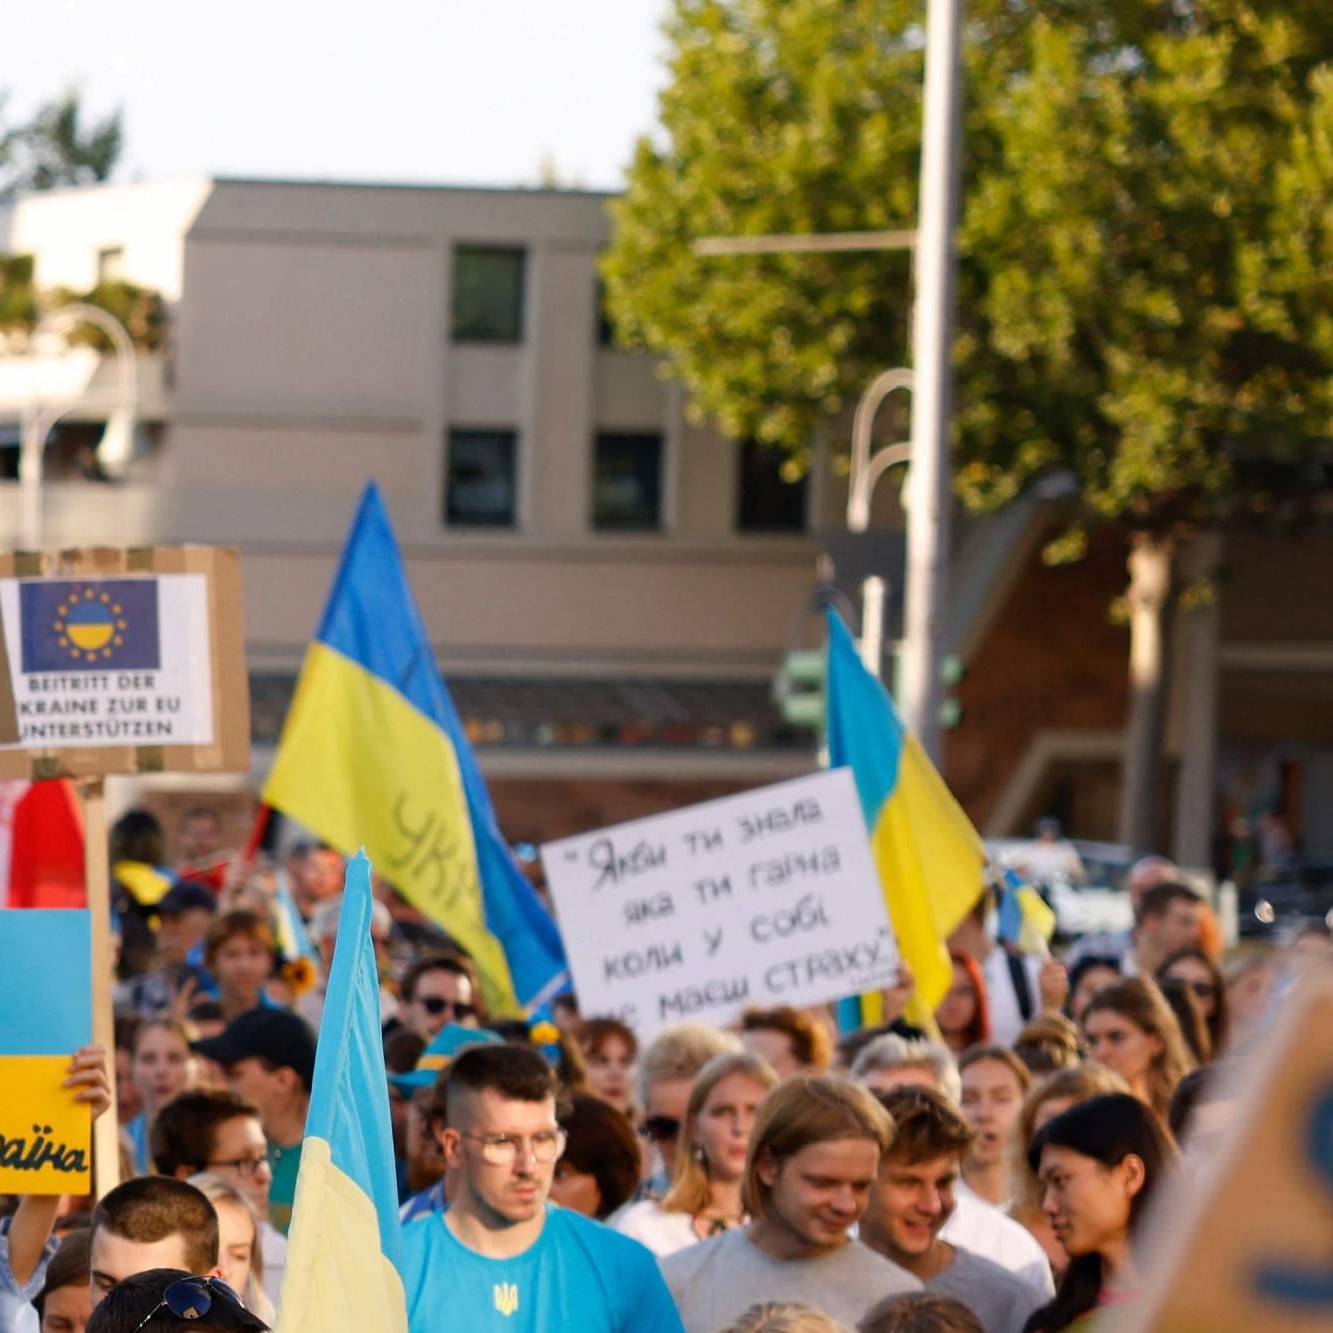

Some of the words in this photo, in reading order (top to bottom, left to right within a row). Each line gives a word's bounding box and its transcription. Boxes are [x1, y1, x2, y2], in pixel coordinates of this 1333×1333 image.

[20, 699, 98, 715] KRAINE
[107, 698, 148, 714] ZUR
[156, 697, 181, 712] EU
[29, 675, 110, 692] BEITRITT
[118, 674, 155, 690] DER
[683, 830, 724, 856] ти
[737, 796, 823, 843] знала
[625, 890, 674, 925] яка
[695, 877, 732, 904] ти
[603, 944, 683, 985] коли
[704, 926, 723, 961] у
[751, 893, 829, 944] собі
